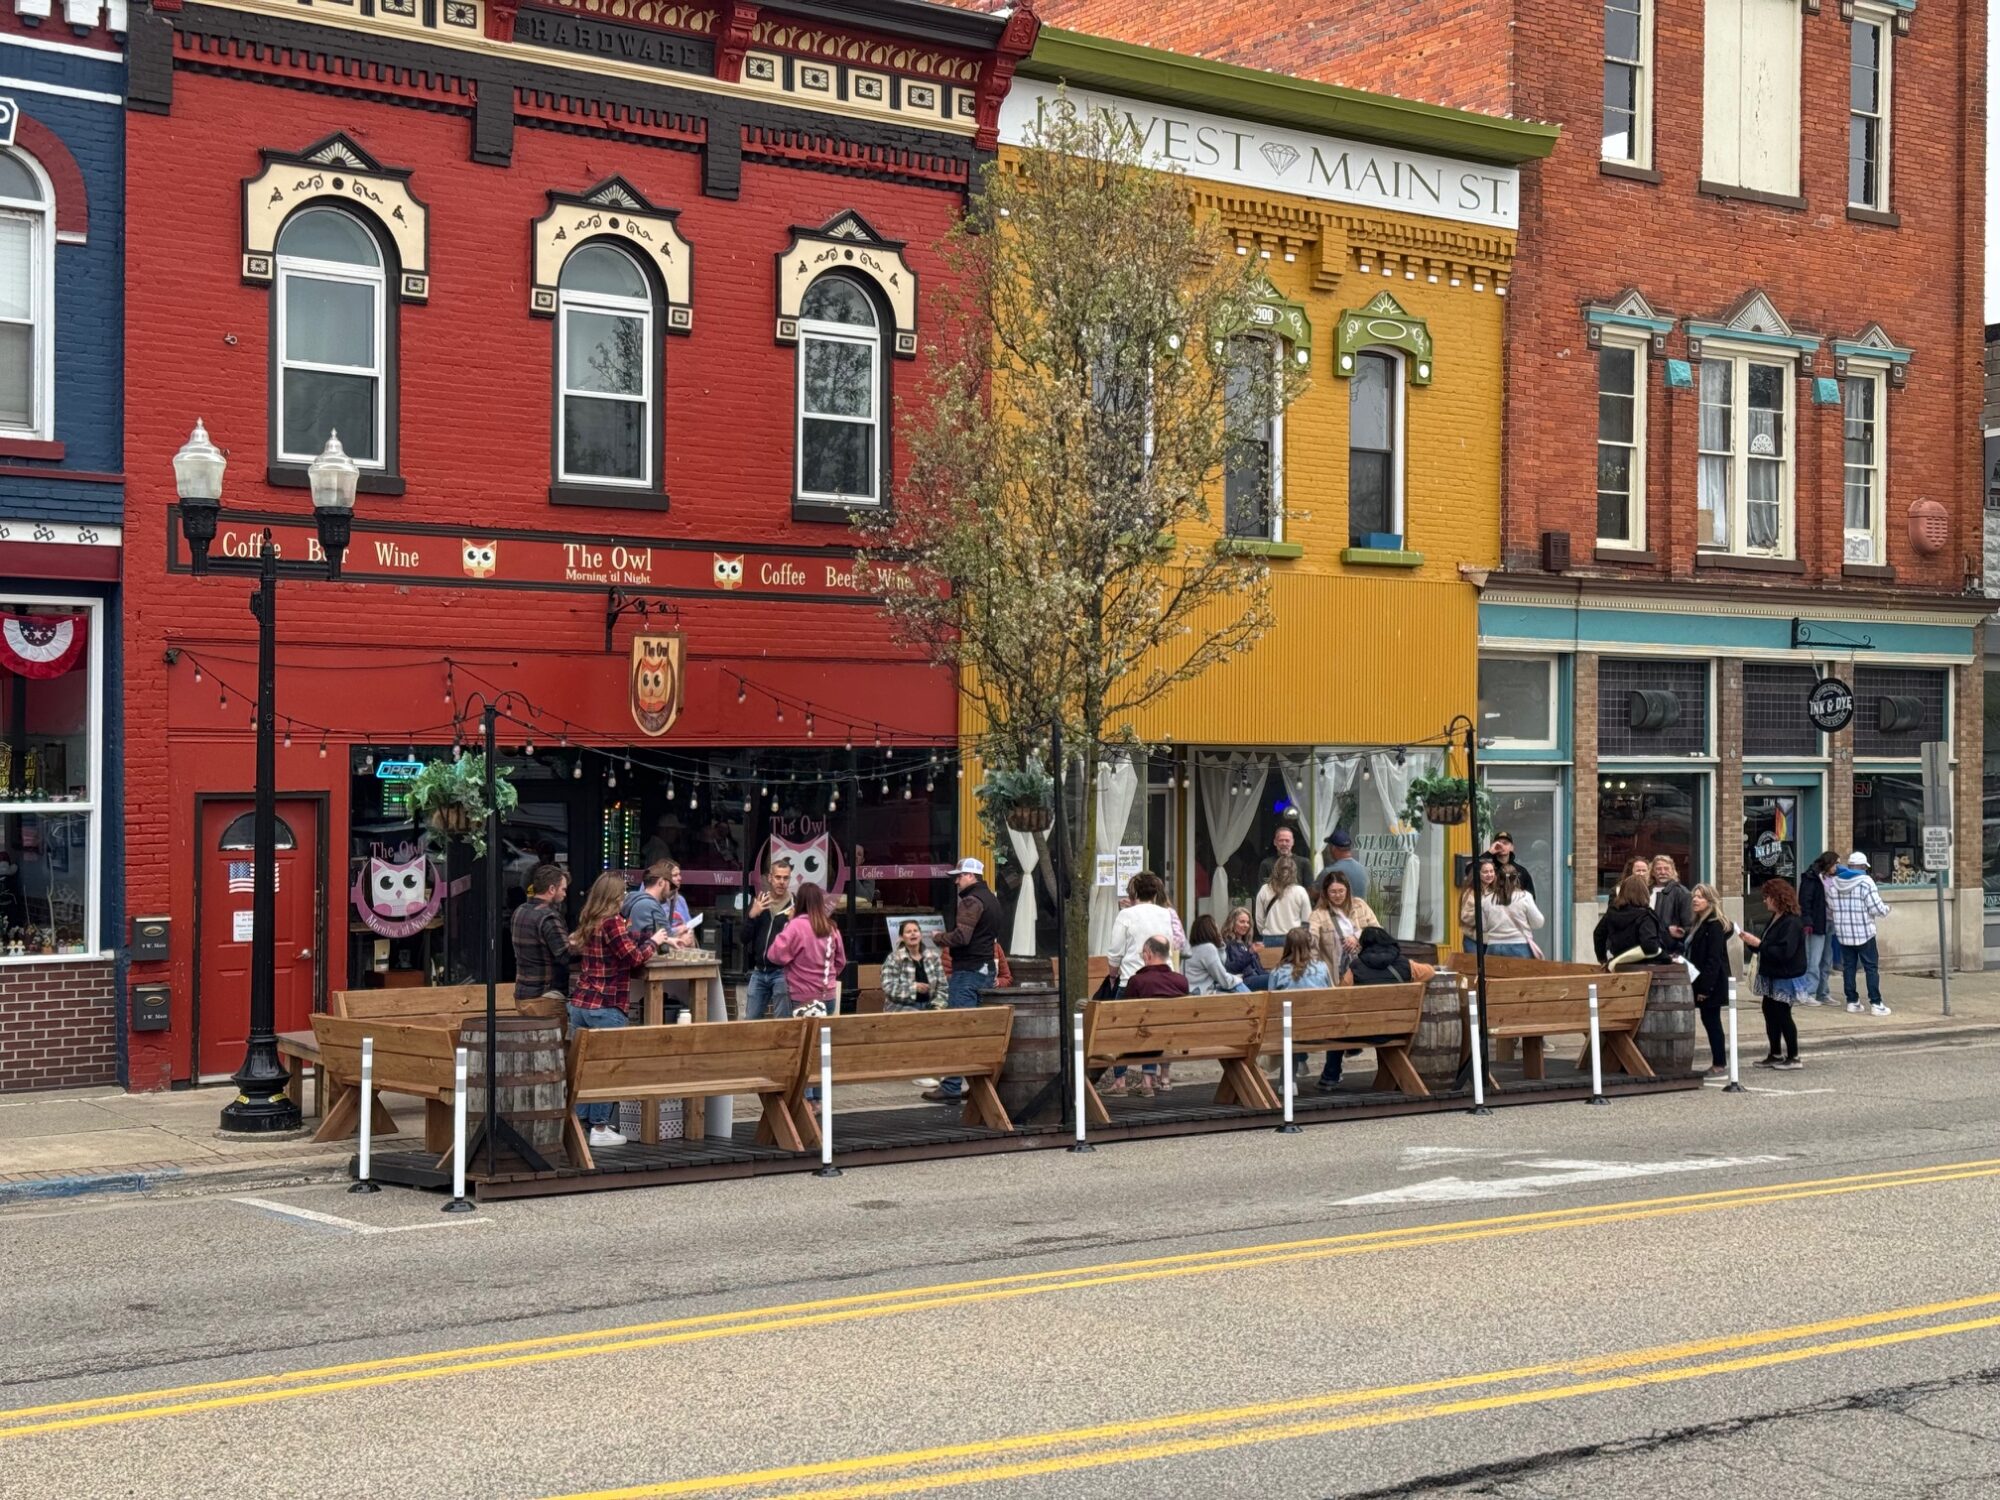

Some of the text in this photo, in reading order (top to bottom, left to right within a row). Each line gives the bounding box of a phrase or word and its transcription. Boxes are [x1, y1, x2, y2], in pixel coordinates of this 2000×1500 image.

[530, 16, 697, 68] HARDWARE
[1100, 106, 1255, 171] WEST
[1306, 146, 1443, 204] MAIN
[1458, 173, 1511, 216] ST.
[222, 531, 282, 558] Coffe
[374, 541, 420, 568] Wine
[563, 543, 653, 571] The Owl
[565, 568, 608, 583] Morning
[624, 571, 652, 584] Night
[760, 562, 806, 586] Coffee
[825, 565, 858, 588] Beer
[1808, 695, 1853, 716] INK & DYE
[381, 765, 420, 776] OPEN
[768, 813, 828, 836] The Owl
[369, 841, 394, 859] The
[1353, 833, 1420, 851] SHADOW
[861, 867, 884, 879] Coffee
[898, 867, 914, 879] Beer
[366, 913, 400, 937] Morning
